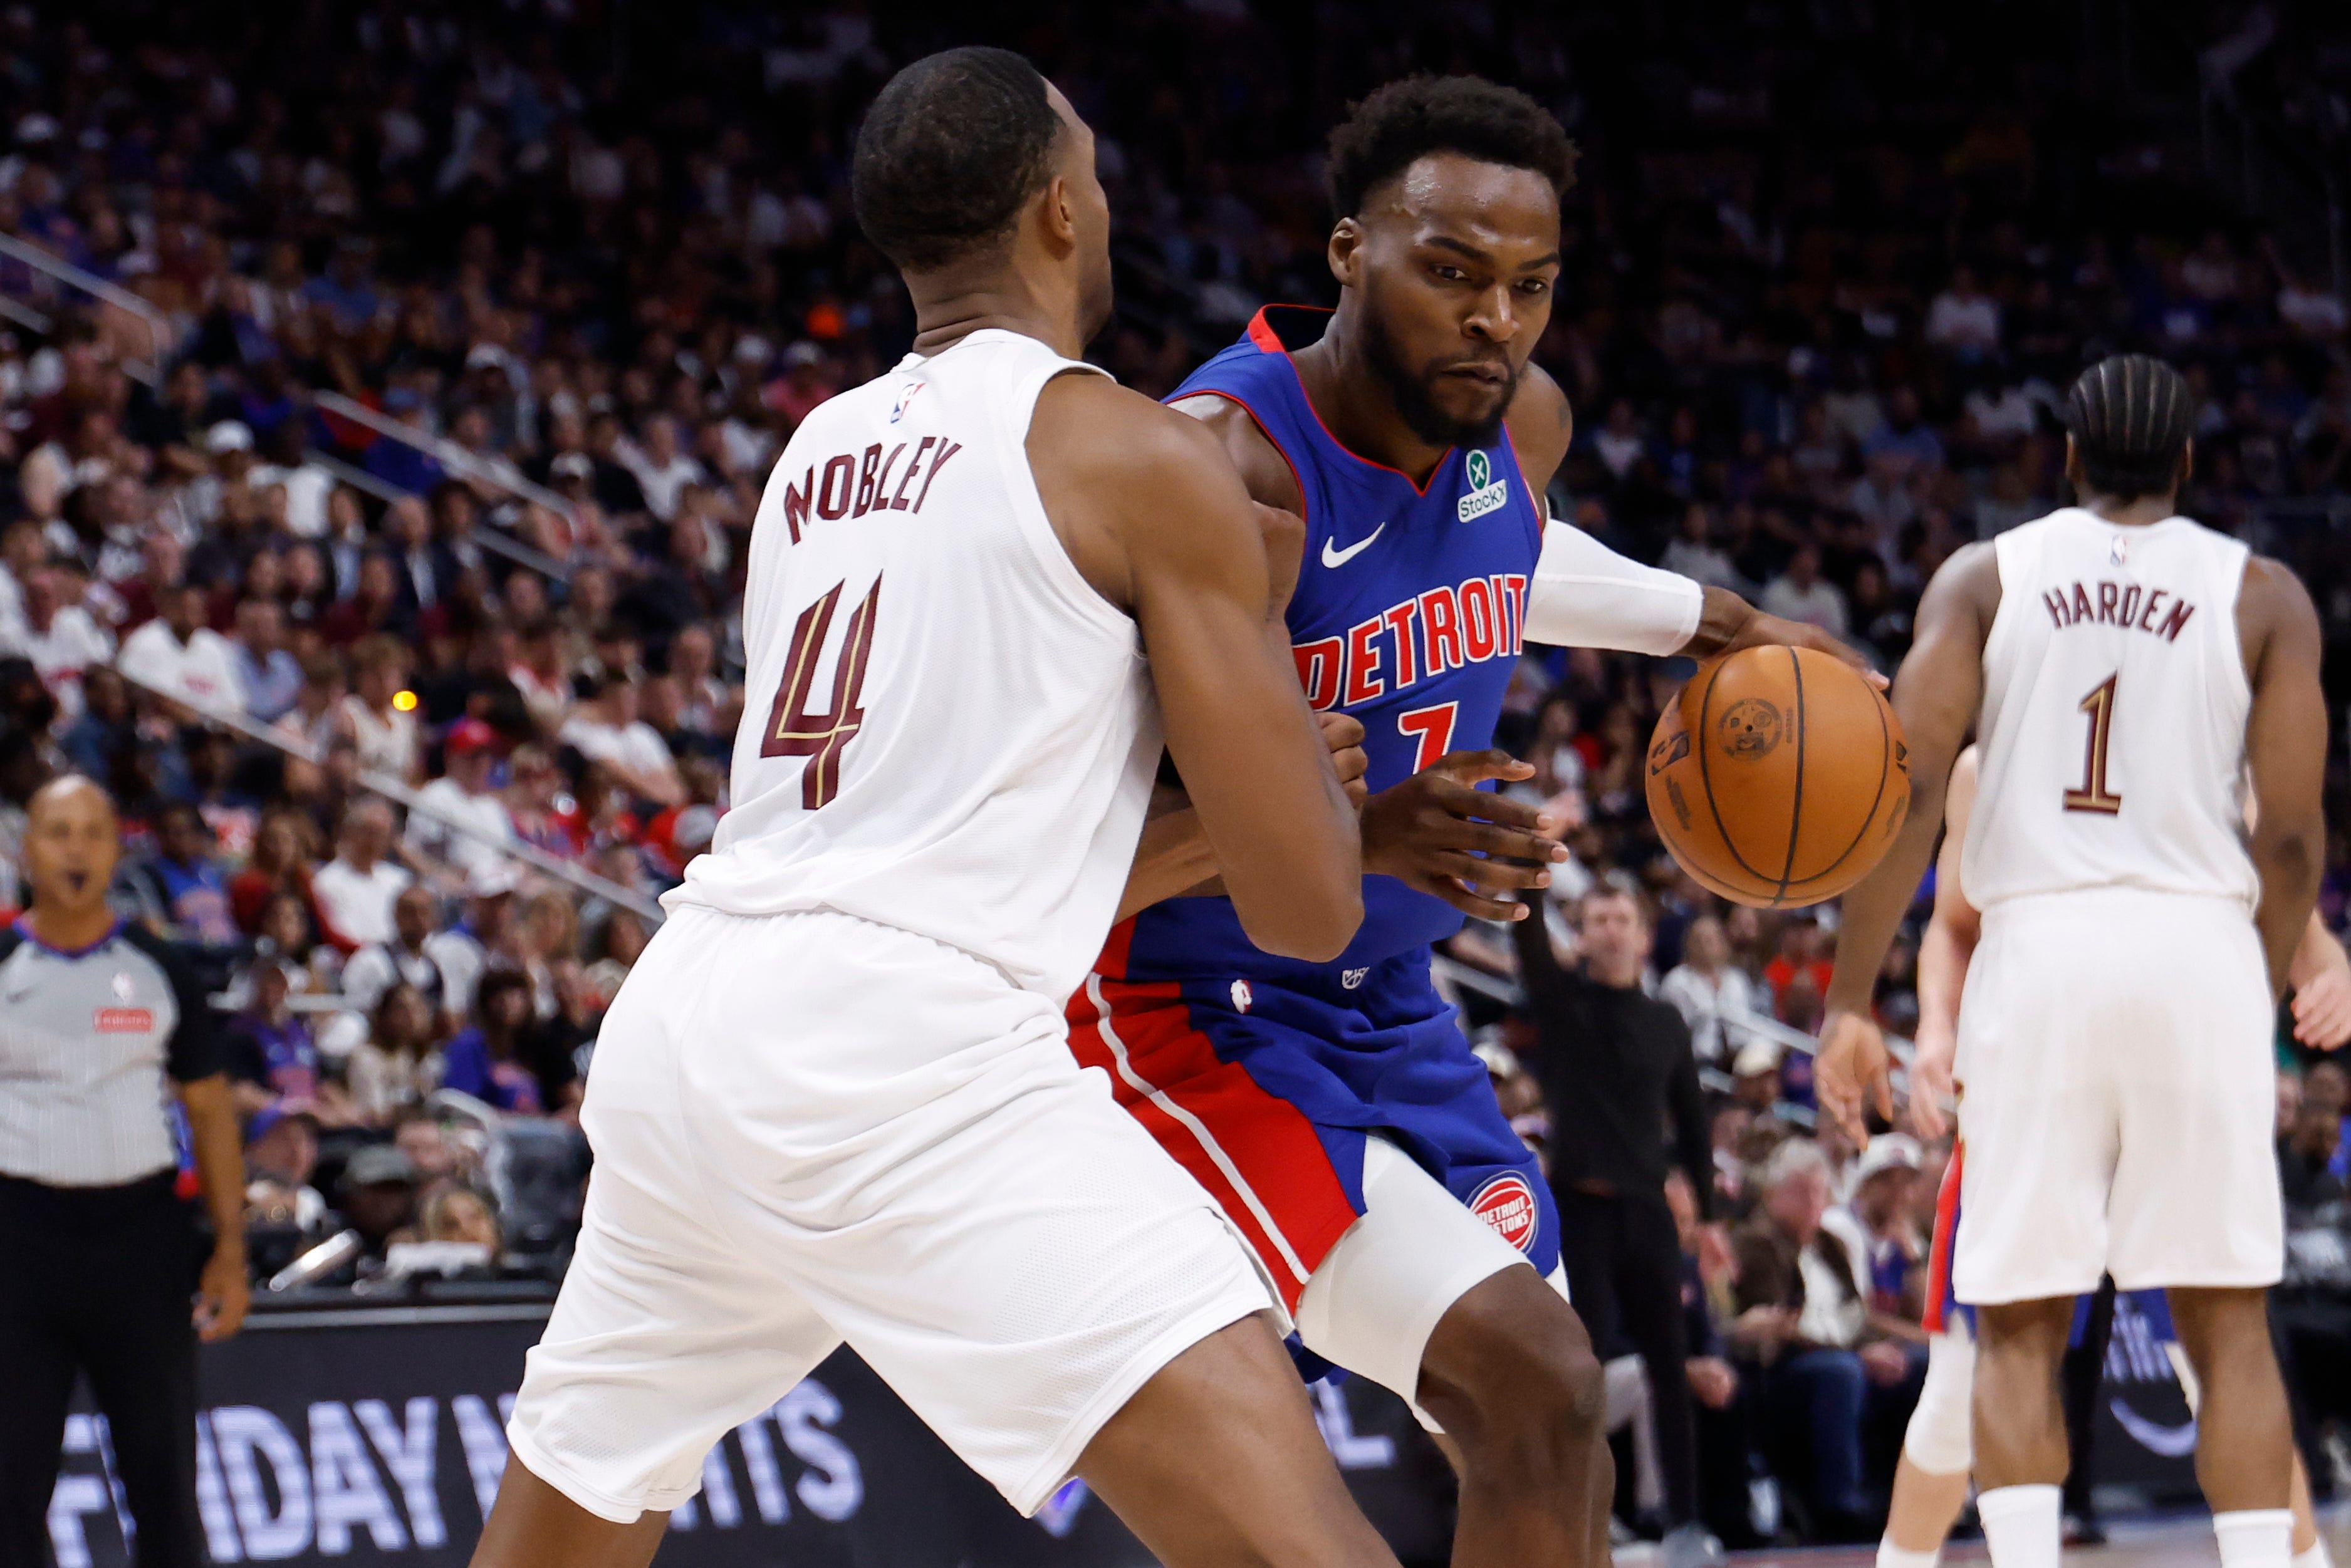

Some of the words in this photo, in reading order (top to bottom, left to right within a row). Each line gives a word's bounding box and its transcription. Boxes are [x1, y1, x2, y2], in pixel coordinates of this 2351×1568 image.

[1291, 573, 1527, 712] DETROIT
[2041, 580, 2195, 644] HARDEN
[760, 569, 883, 810] 4
[1397, 701, 1459, 775] 7
[2062, 669, 2122, 818] 1
[1492, 1210, 1529, 1234] STONS
[45, 1395, 449, 1568] FIDAY
